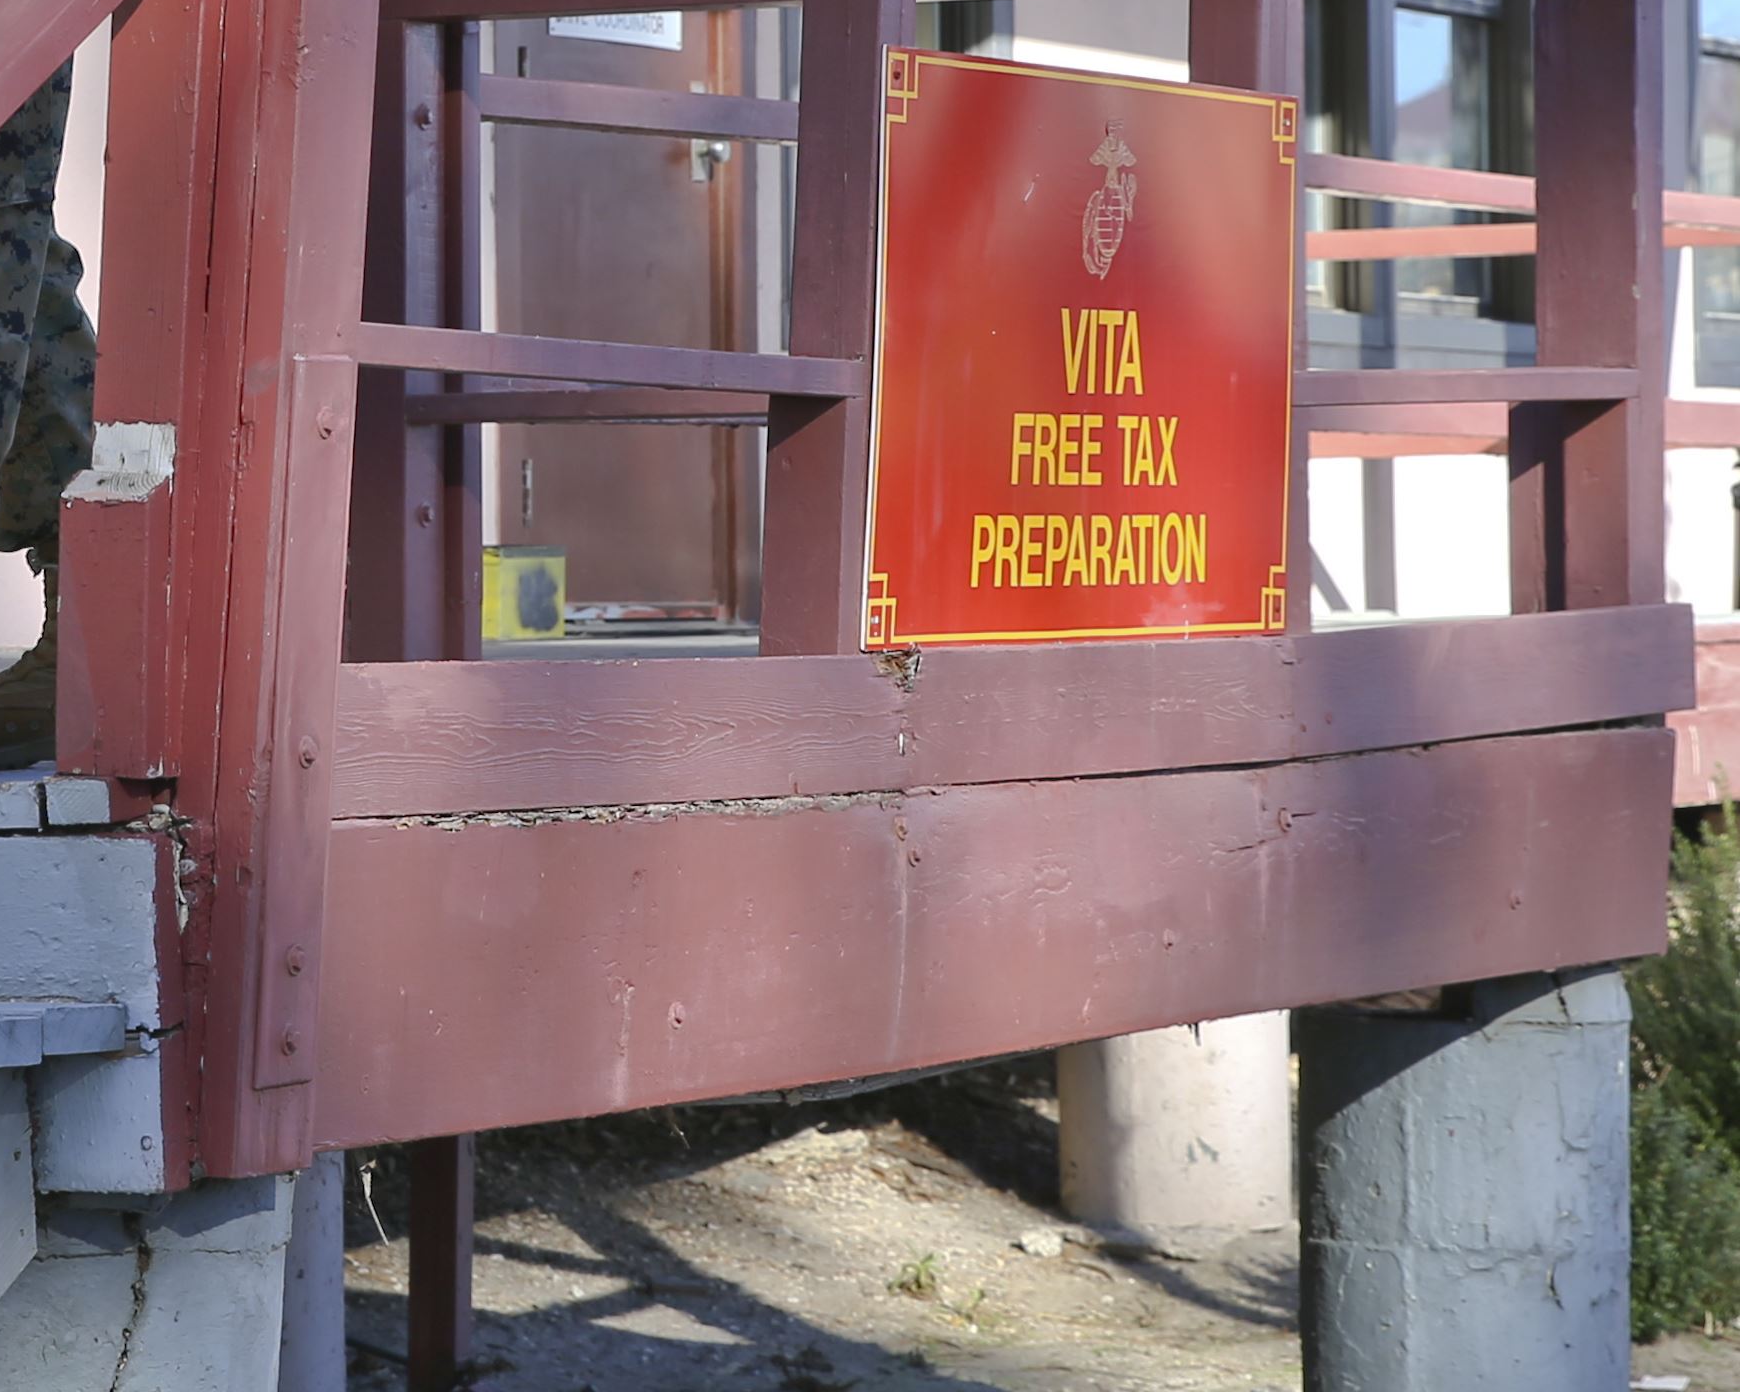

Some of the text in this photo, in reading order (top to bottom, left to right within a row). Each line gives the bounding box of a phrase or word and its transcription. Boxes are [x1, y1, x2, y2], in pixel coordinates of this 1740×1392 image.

[1061, 308, 1144, 395] VITA
[1010, 413, 1178, 486] FREE TAX
[970, 512, 1207, 588] PREPARATION
